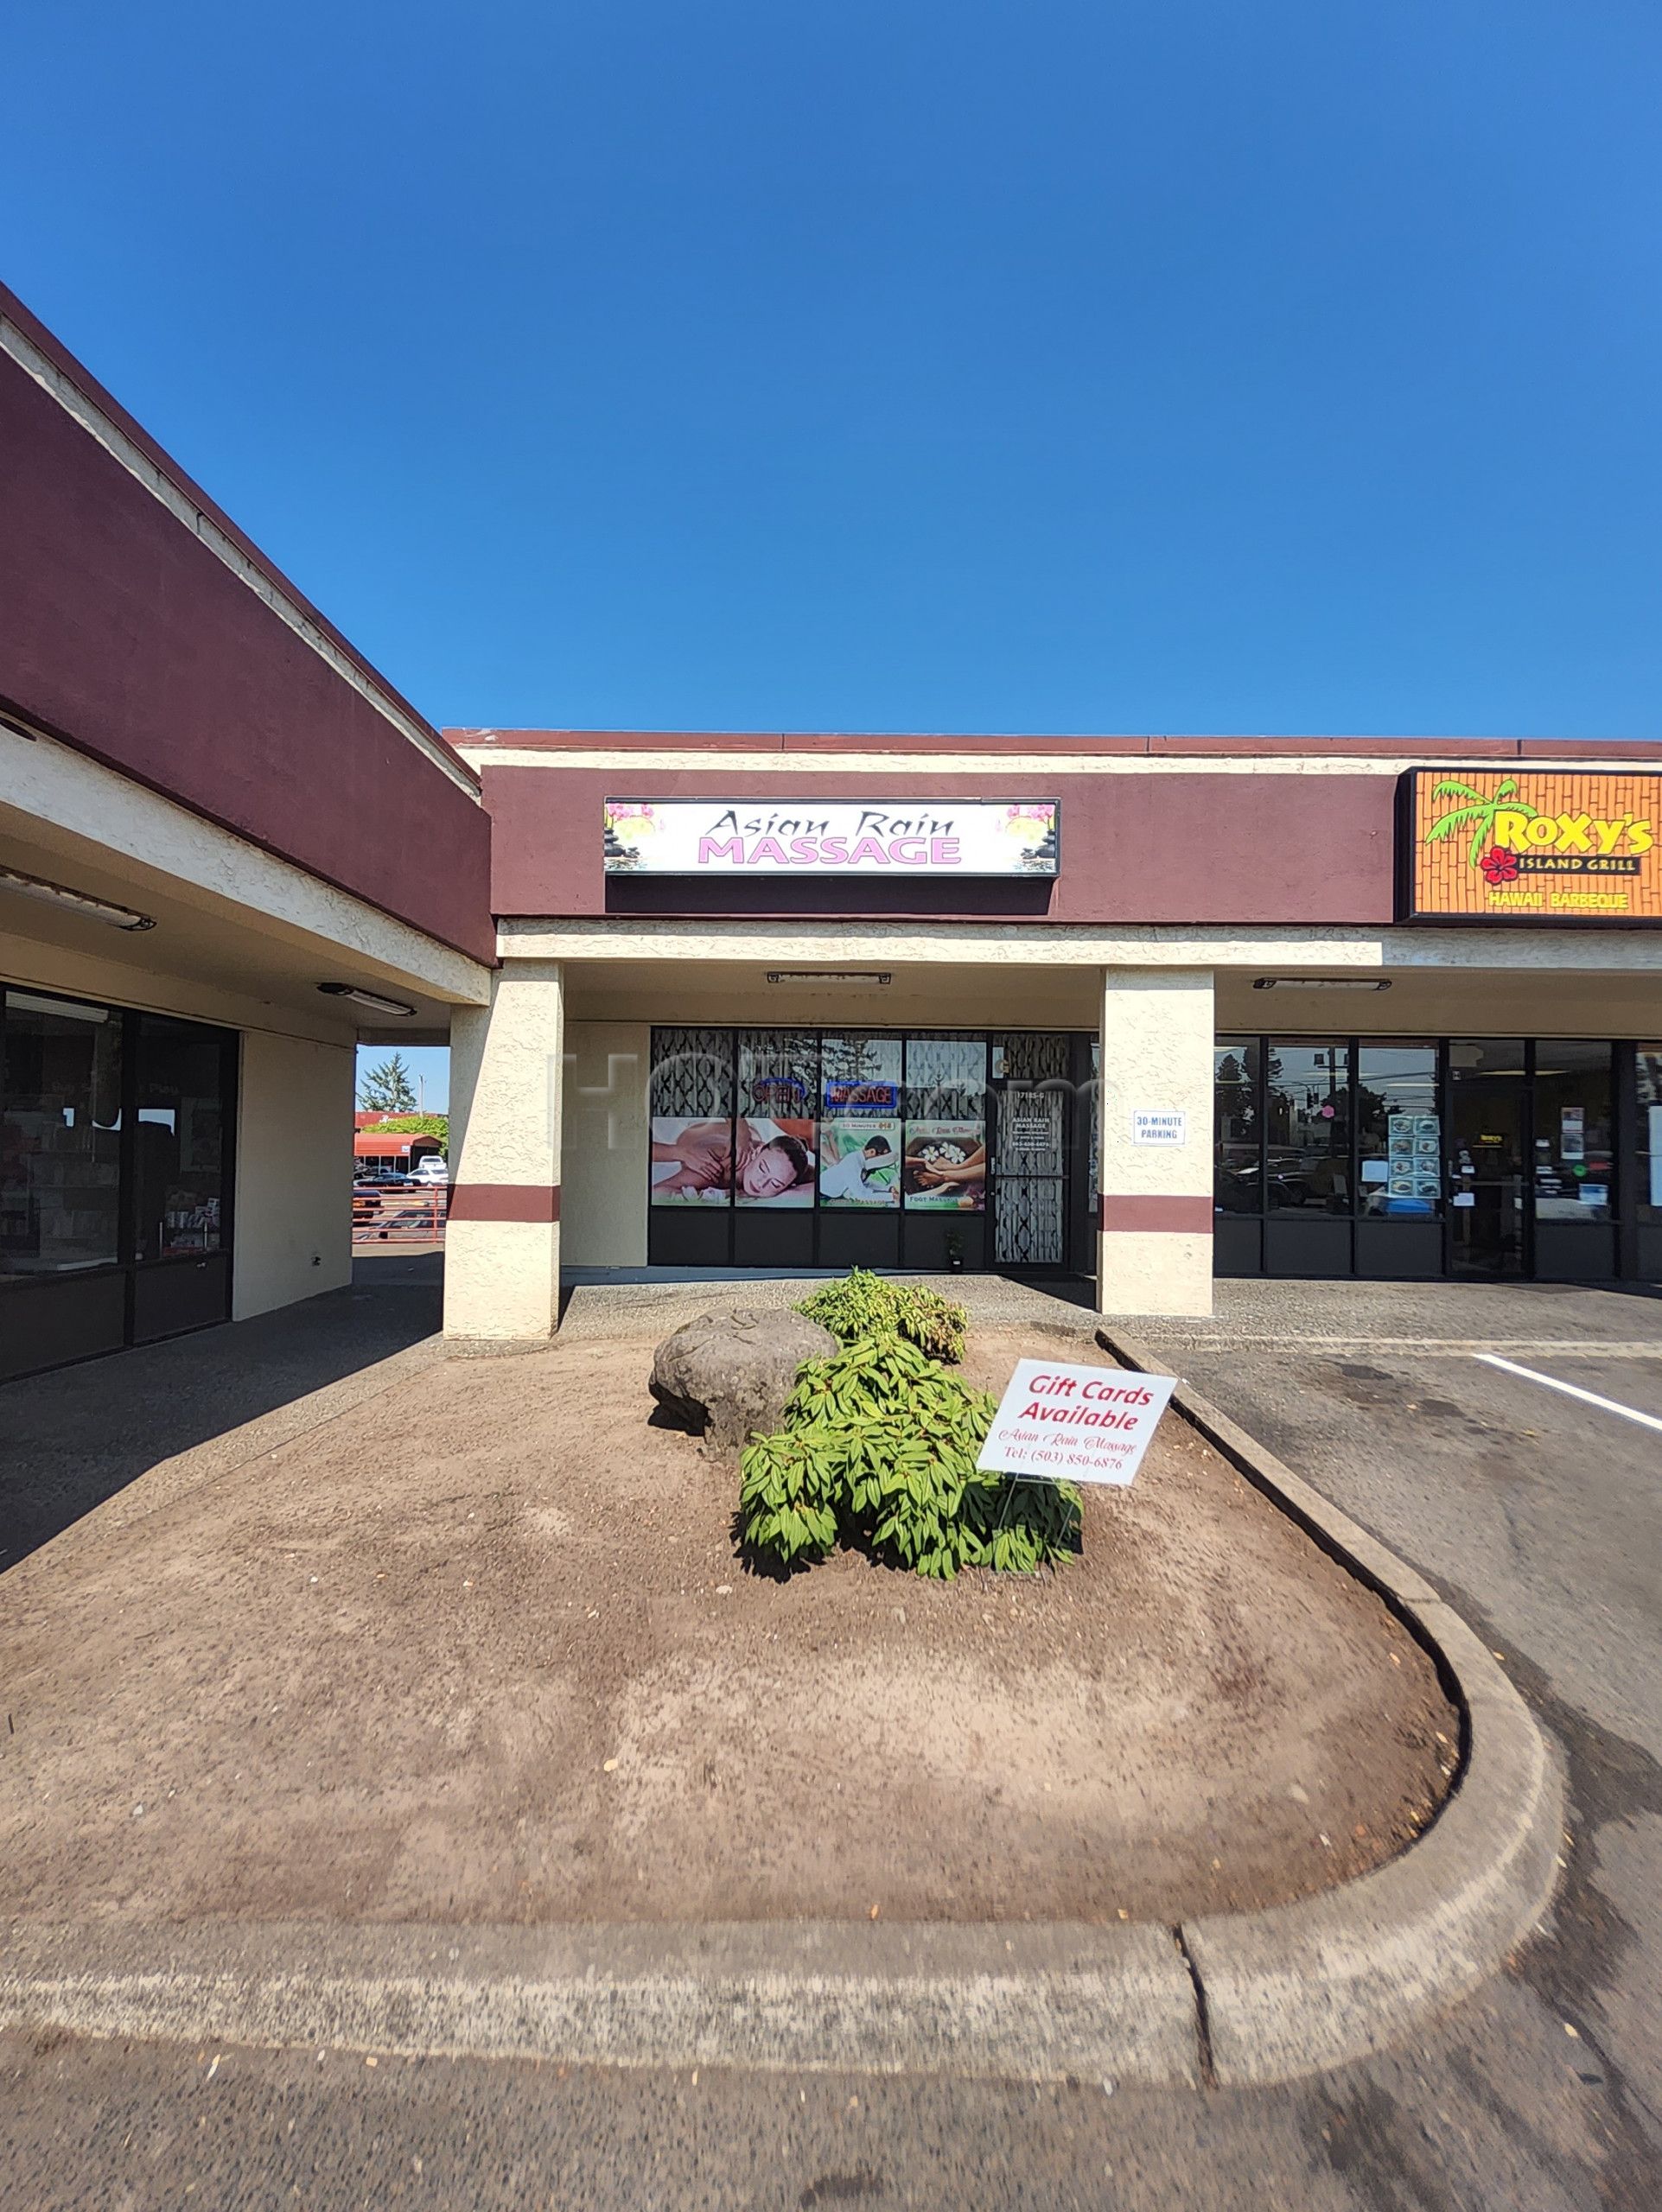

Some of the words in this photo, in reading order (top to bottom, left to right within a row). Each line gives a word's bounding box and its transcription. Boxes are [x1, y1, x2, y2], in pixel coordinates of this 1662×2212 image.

[705, 810, 829, 837] Asian
[855, 810, 955, 836] Rain
[697, 836, 961, 864] MASSAGE
[1519, 857, 1582, 869] ISLAND
[1587, 859, 1636, 870] GRILL
[1488, 891, 1543, 906] HAWAII
[1550, 893, 1628, 908] BARBEQUE
[752, 1084, 803, 1103] OPEN
[830, 1085, 892, 1104] MASSAGE
[1137, 1116, 1182, 1126] 30-MINUTE
[1141, 1129, 1177, 1139] PARKING
[1028, 1375, 1078, 1397] Gift
[1081, 1381, 1155, 1406] Cards
[1017, 1402, 1139, 1431] Available
[998, 1428, 1039, 1443] Asian
[1042, 1432, 1079, 1446] Rain
[1083, 1436, 1137, 1455] Massage
[1004, 1446, 1028, 1460] Tel:
[1030, 1449, 1064, 1464] (503)
[1067, 1453, 1123, 1471] 850-6876
